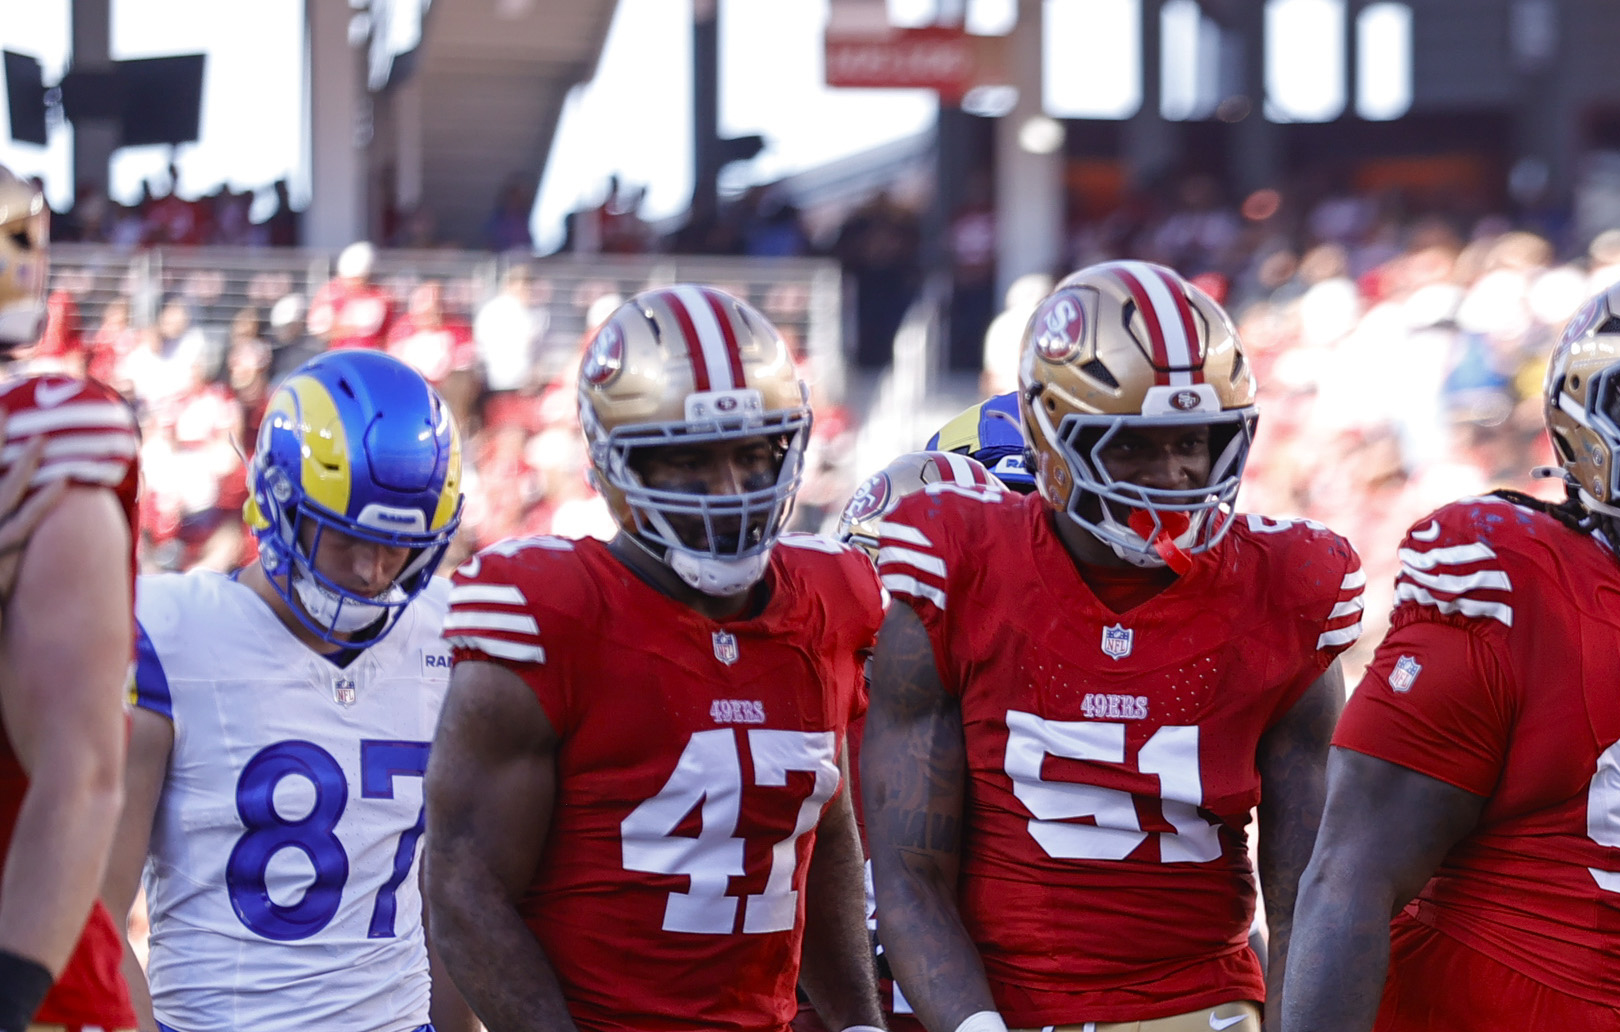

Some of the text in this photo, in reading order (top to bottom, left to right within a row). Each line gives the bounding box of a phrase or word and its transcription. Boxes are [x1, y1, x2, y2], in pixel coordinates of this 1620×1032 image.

[1106, 638, 1126, 653] NFL
[425, 655, 452, 668] RA
[336, 689, 355, 700] NFL
[1079, 693, 1148, 720] 49ERS
[709, 699, 766, 724] 49ERS
[1003, 709, 1223, 863] 51
[225, 739, 433, 942] 87
[620, 728, 841, 934] 47
